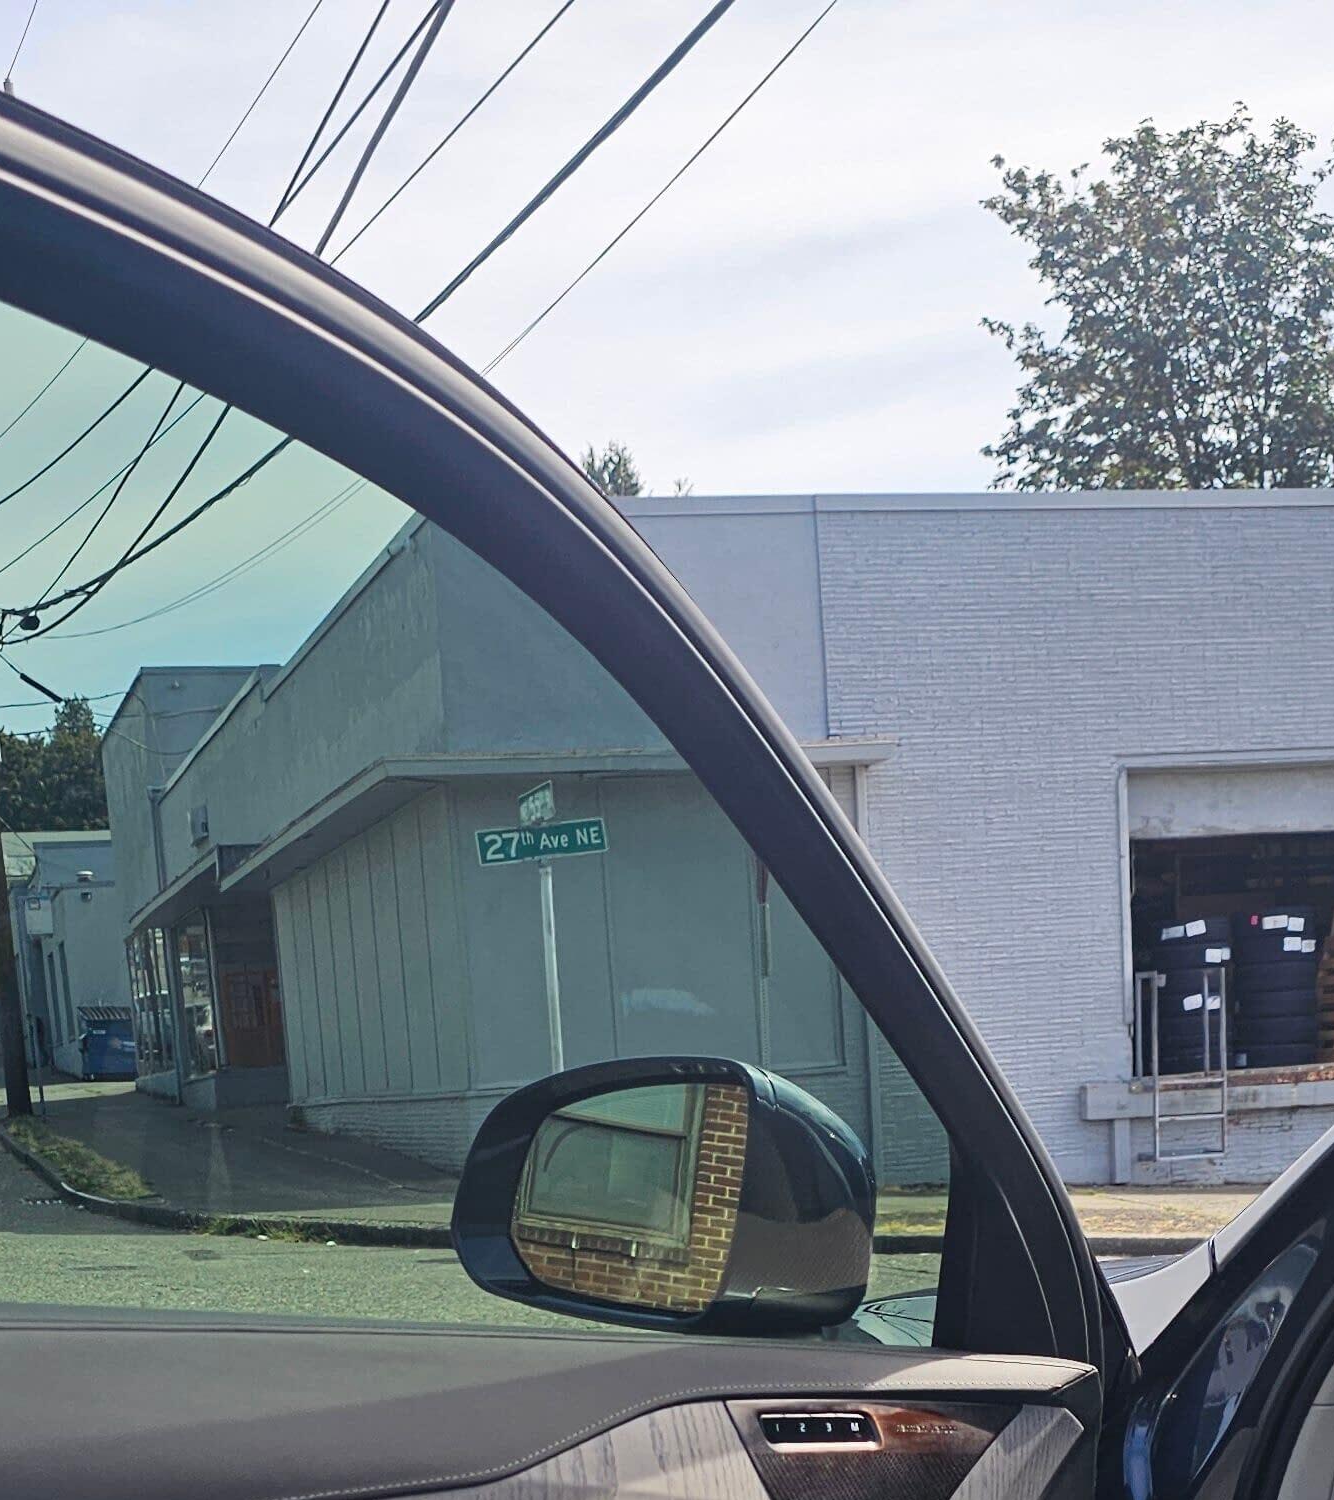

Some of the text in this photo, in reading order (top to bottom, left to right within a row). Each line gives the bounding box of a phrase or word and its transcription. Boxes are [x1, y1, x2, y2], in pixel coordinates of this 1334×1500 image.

[483, 826, 602, 861] 27th Ave NE
[799, 1422, 806, 1433] 2
[825, 1422, 833, 1433] 3
